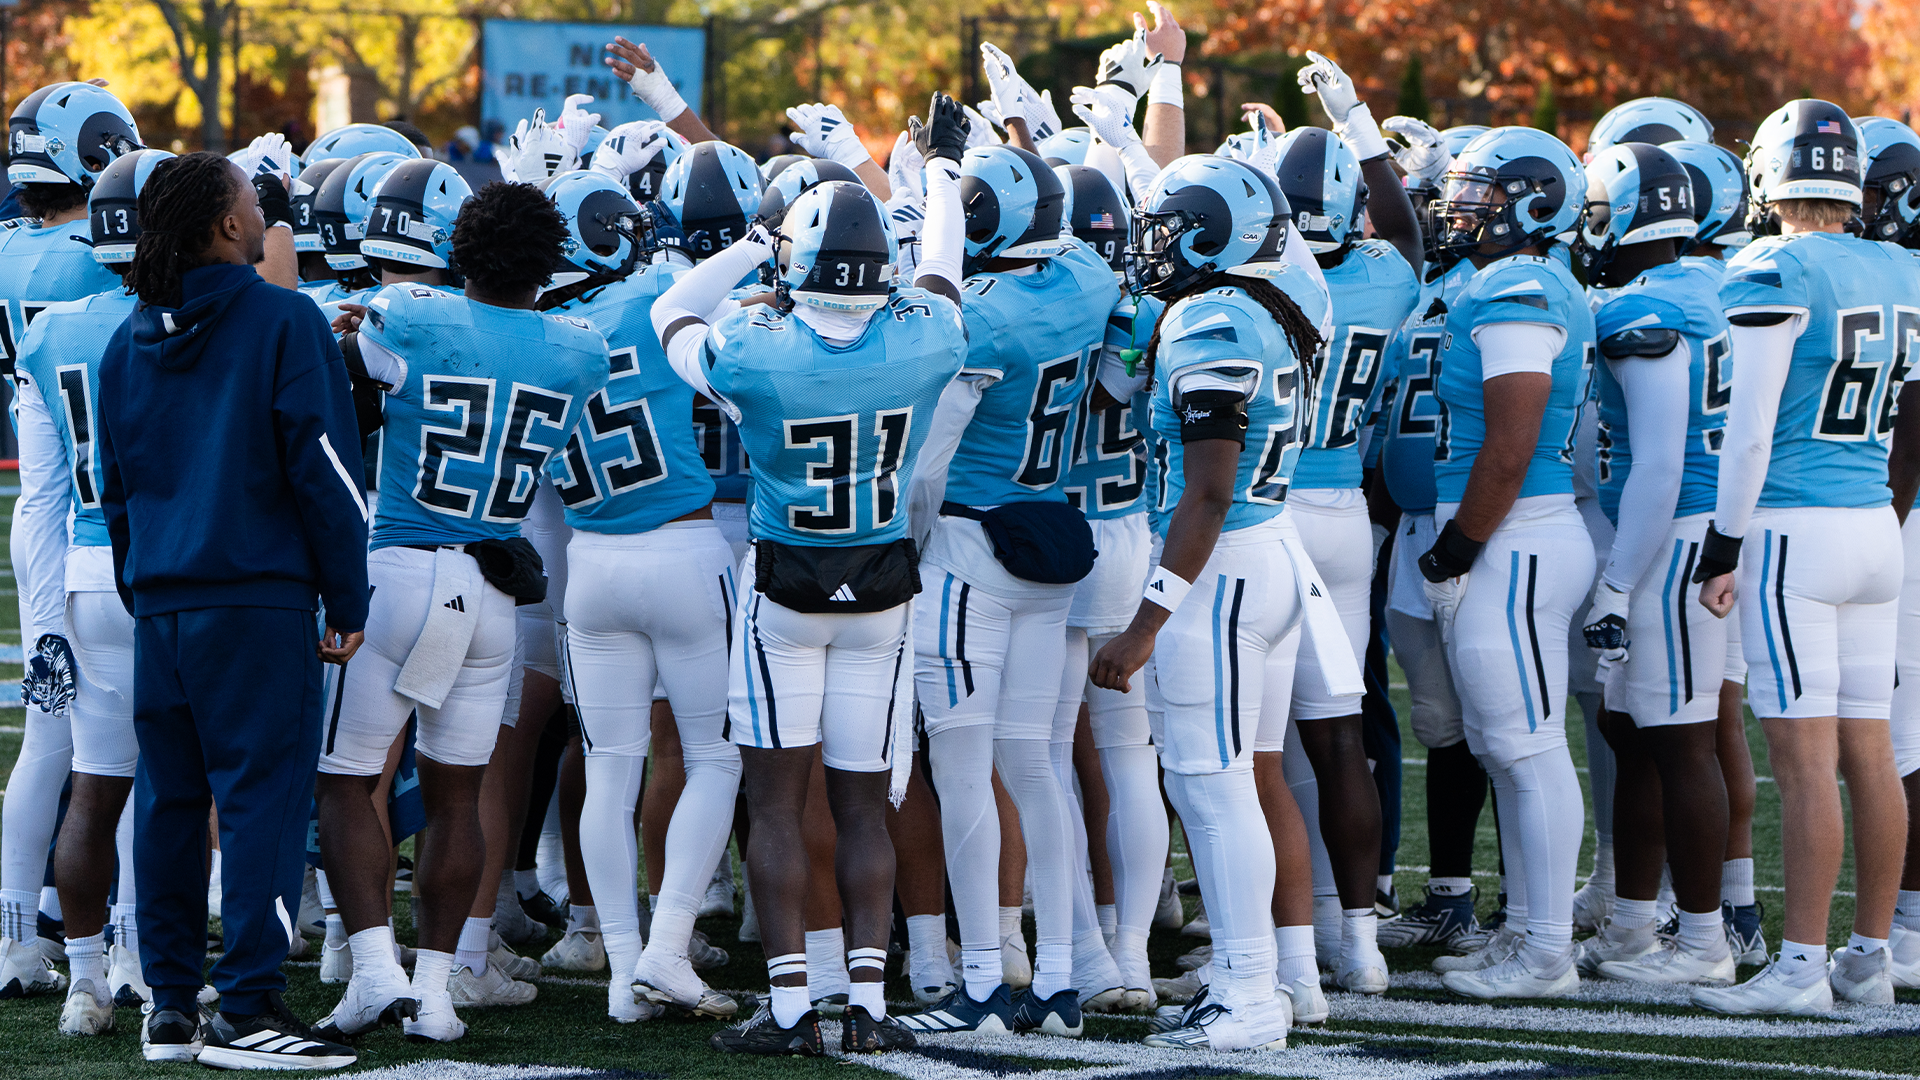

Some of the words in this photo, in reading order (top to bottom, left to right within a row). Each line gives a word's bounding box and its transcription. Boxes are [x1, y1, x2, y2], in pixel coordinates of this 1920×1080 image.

[1811, 146, 1844, 172] 66
[1658, 186, 1688, 211] 54
[1803, 186, 1831, 194] MORE
[1833, 188, 1854, 197] FEET
[101, 208, 129, 235] 13
[381, 207, 411, 235] 70
[1242, 232, 1259, 240] CAA
[101, 252, 122, 260] MORE
[125, 251, 137, 259] FE
[372, 246, 394, 257] MORE
[396, 251, 422, 261] FEET
[793, 261, 806, 271] CAA
[835, 262, 866, 287] 31
[807, 297, 820, 305] #3
[823, 300, 852, 310] MORE
[854, 302, 878, 311] FEET
[411, 374, 574, 524] 26
[782, 405, 914, 534] 31
